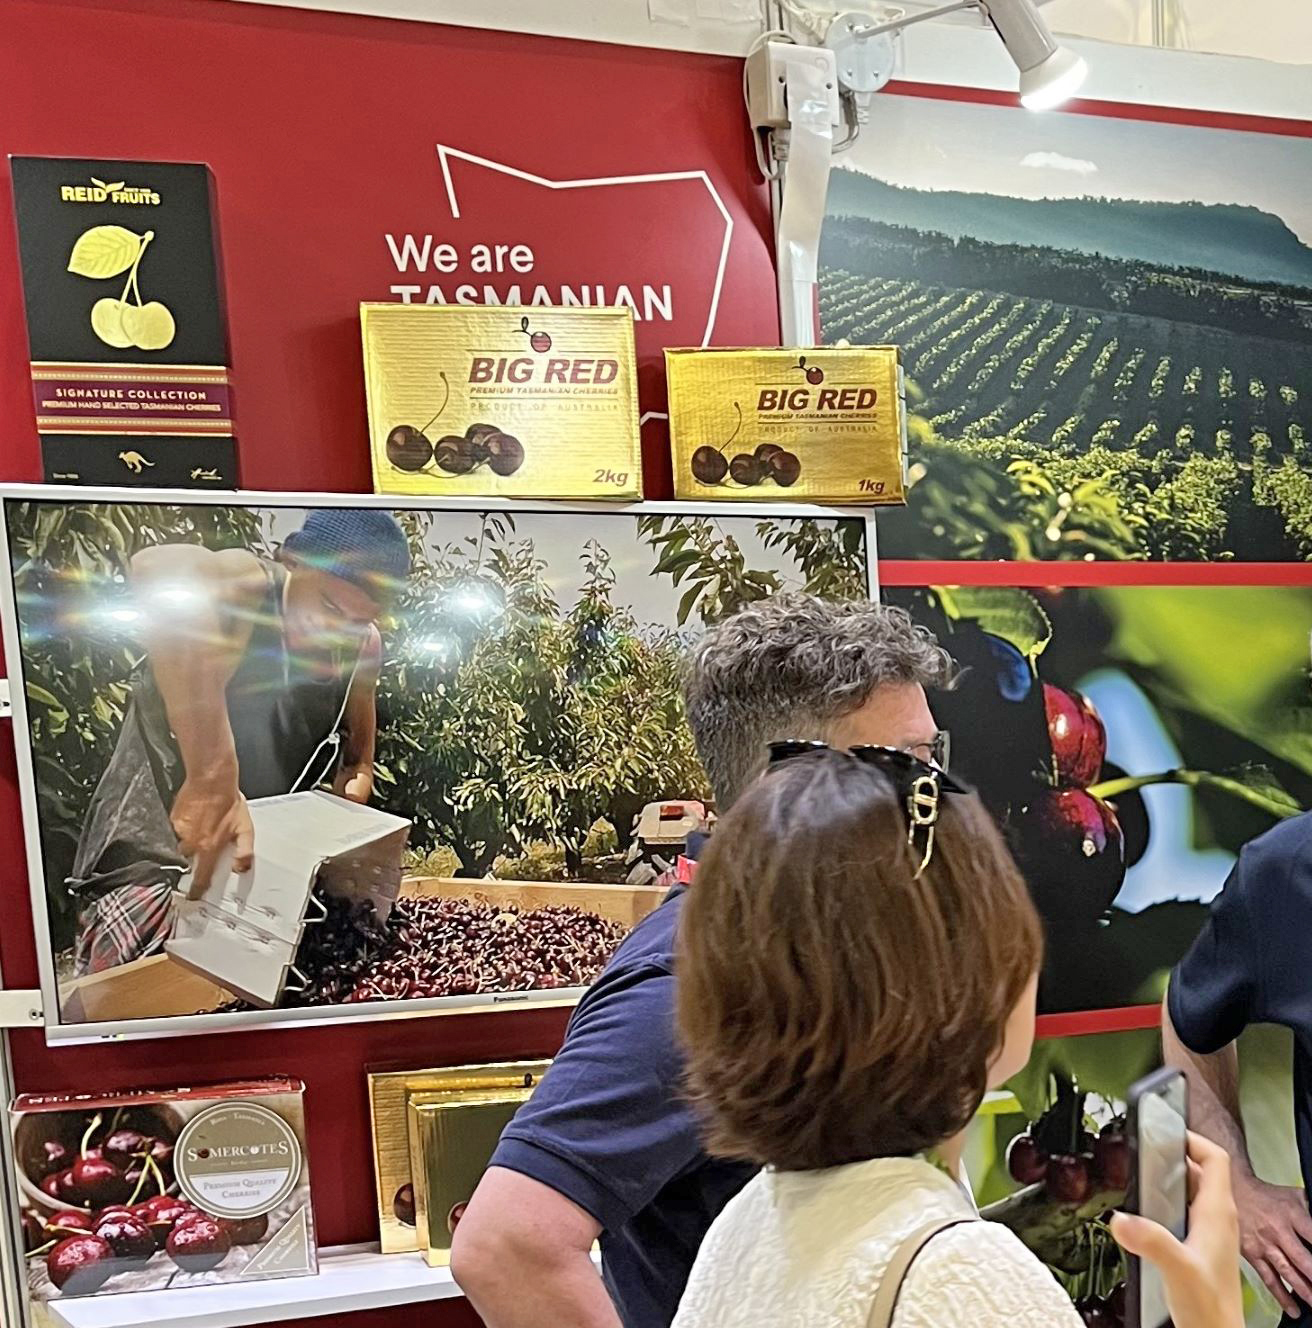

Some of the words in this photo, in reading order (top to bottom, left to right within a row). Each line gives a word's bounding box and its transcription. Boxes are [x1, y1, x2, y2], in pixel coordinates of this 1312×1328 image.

[61, 186, 107, 202] REID
[112, 191, 160, 205] FRUITS
[385, 234, 458, 272] We
[470, 243, 534, 273] are
[468, 357, 534, 383] BIG
[544, 358, 619, 384] RED
[56, 388, 124, 399] SIGNATURE
[128, 389, 207, 400] COLLECTION
[757, 389, 810, 411] BIG
[817, 388, 877, 411] RED
[593, 469, 628, 487] 2kg
[858, 479, 885, 495] 1kg
